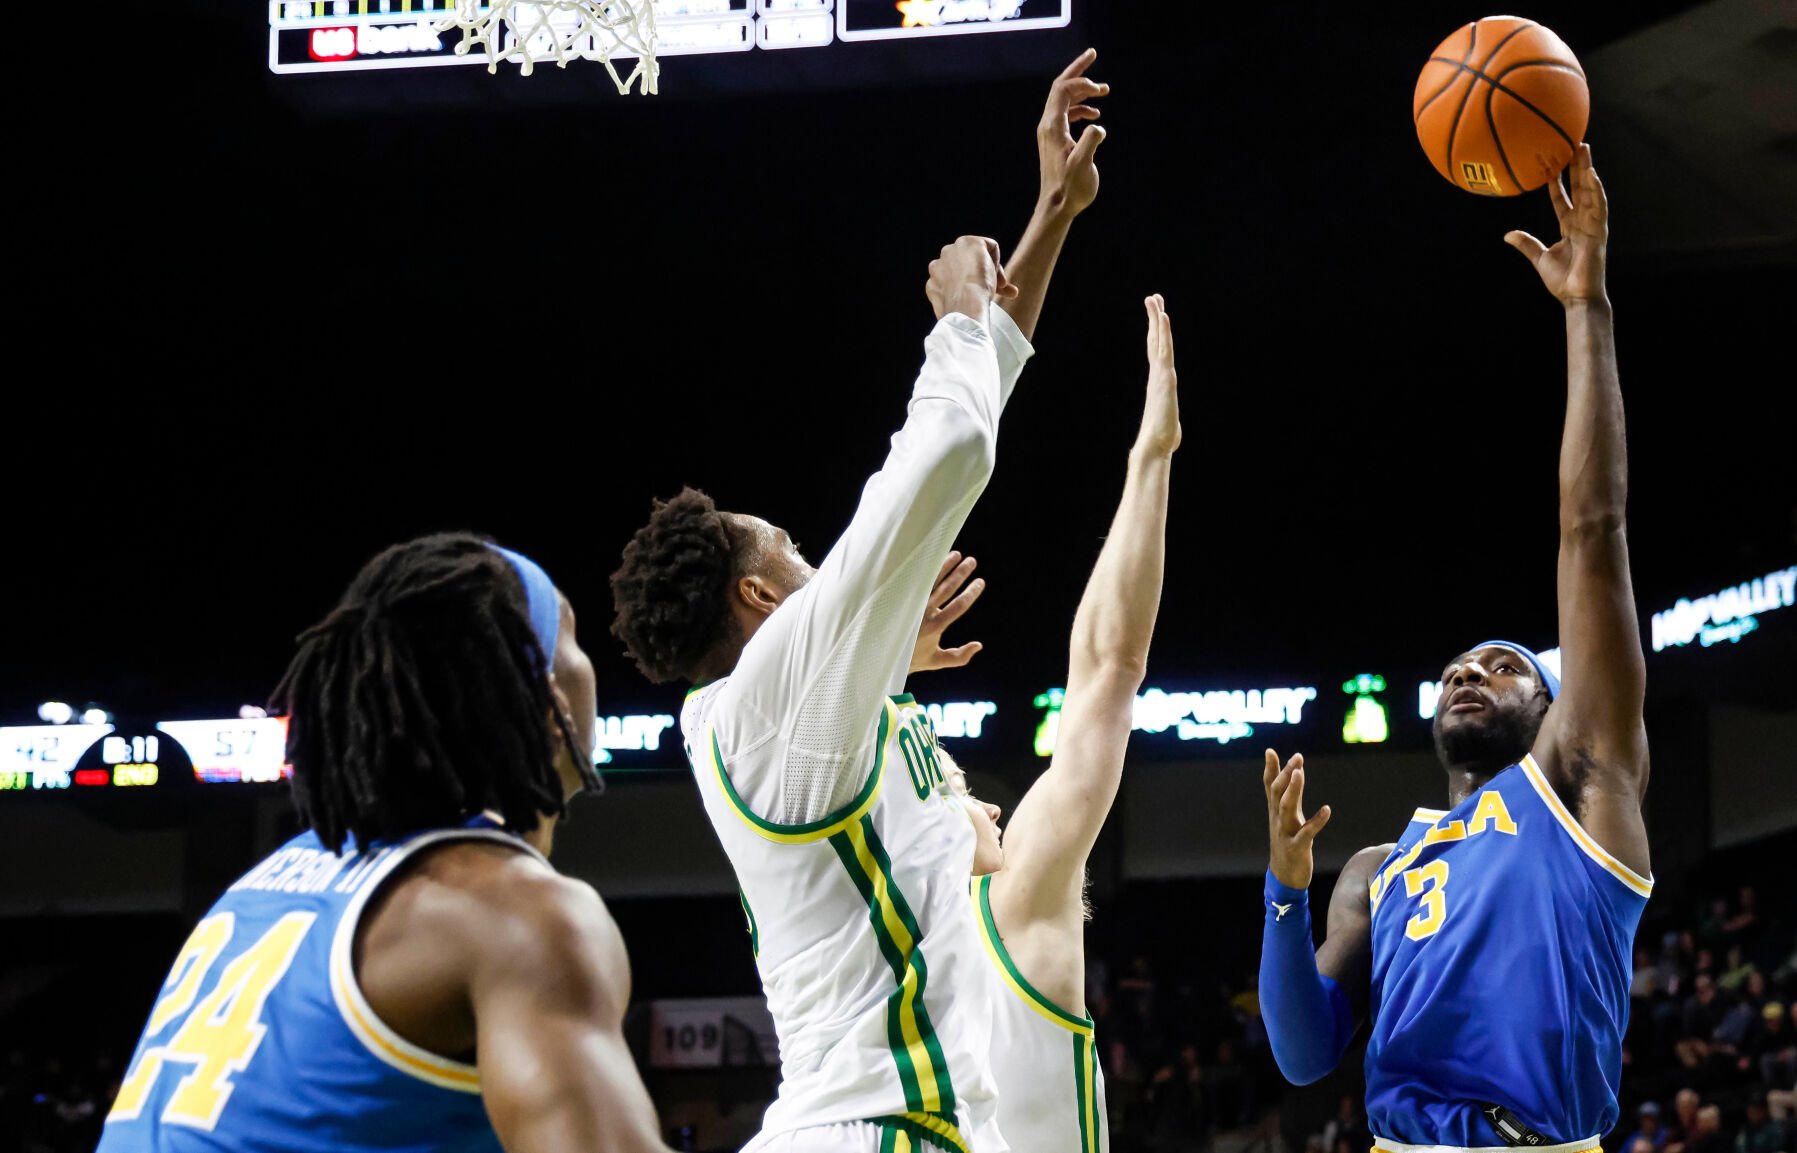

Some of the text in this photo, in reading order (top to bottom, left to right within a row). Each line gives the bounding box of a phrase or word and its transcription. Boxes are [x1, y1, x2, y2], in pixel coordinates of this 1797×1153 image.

[1403, 858, 1449, 942] 3
[104, 910, 318, 1132] 24
[664, 1021, 719, 1051] 109
